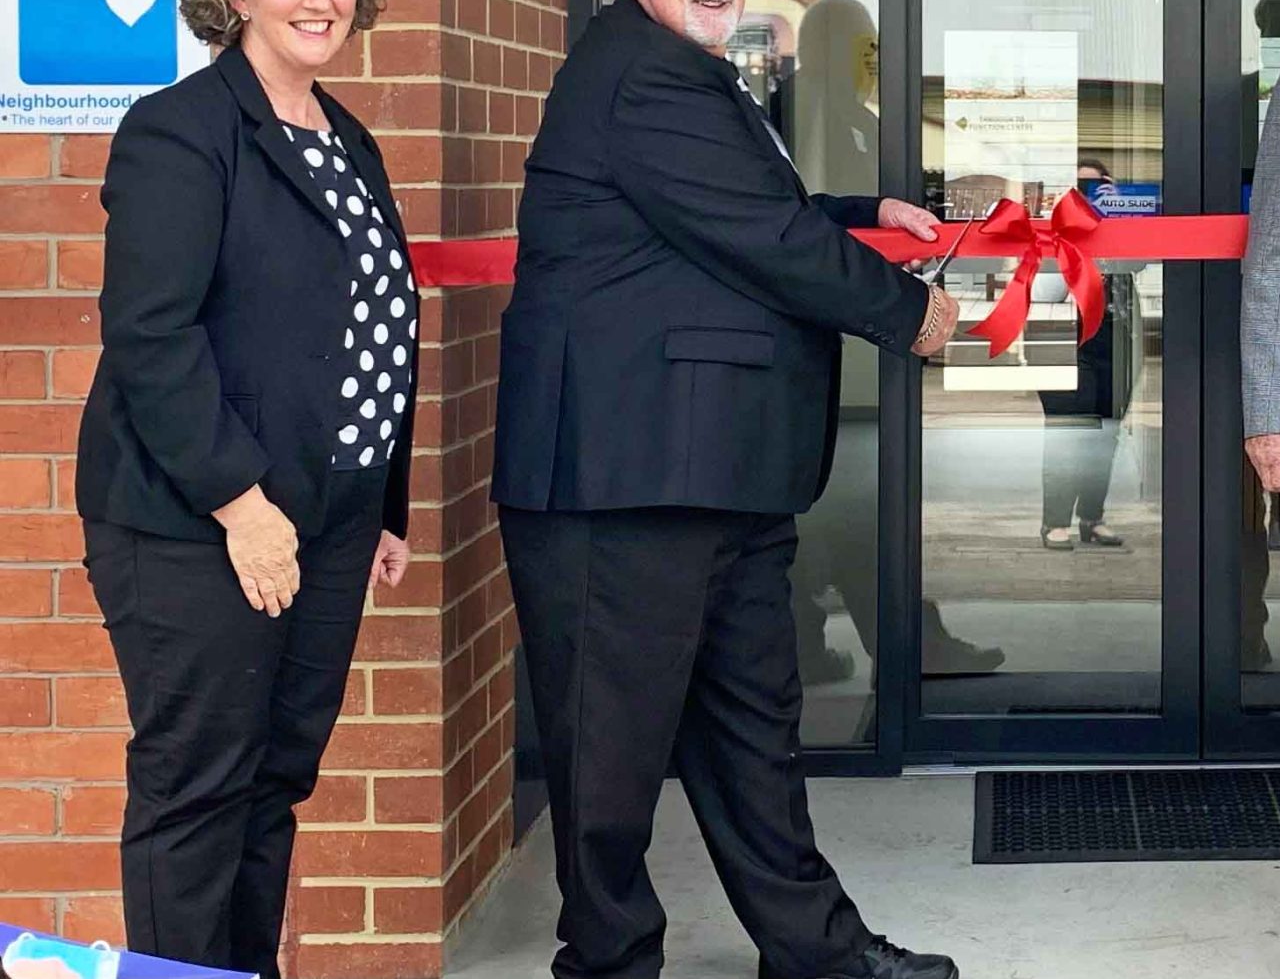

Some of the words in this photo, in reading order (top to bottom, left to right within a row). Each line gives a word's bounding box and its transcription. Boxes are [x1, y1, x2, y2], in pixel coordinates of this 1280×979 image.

[10, 113, 35, 125] The
[39, 113, 72, 125] heart
[76, 113, 89, 125] of
[93, 116, 113, 125] our
[1100, 199, 1125, 208] AUTO
[1127, 199, 1155, 208] SLIDE
